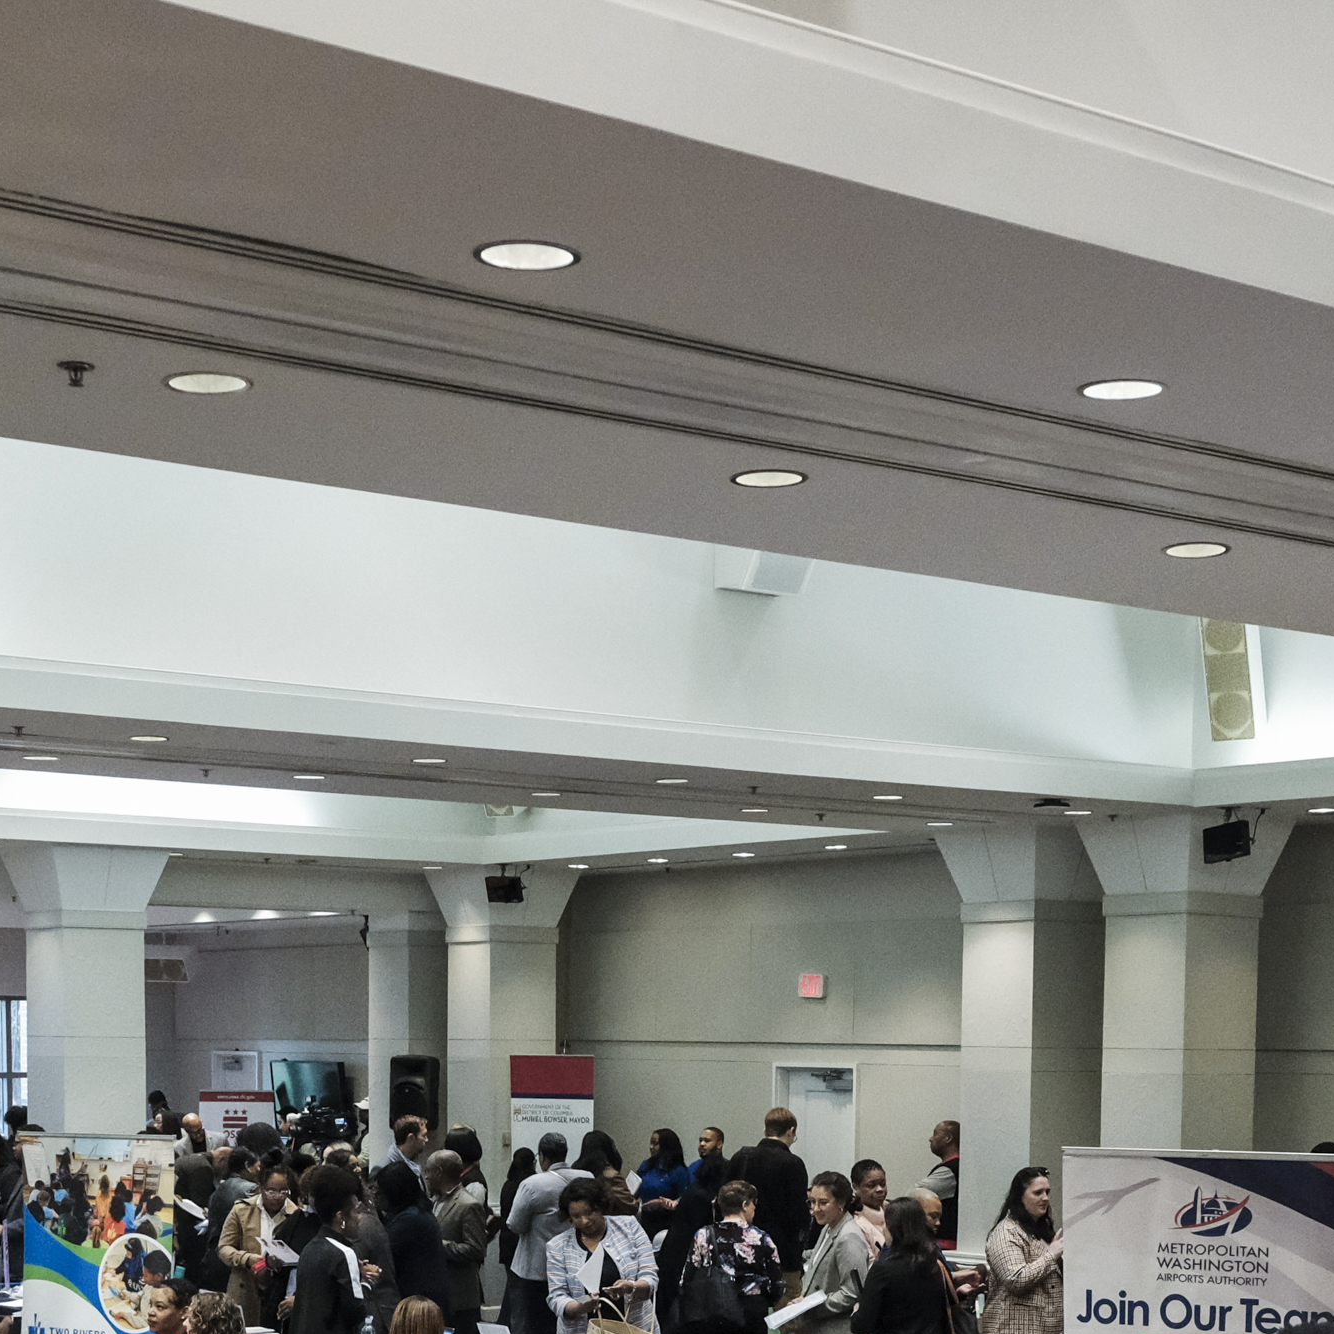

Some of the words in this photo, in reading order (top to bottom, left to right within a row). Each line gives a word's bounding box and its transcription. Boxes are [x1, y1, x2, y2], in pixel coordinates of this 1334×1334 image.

[569, 1116, 590, 1124] MAYOR
[1157, 1242, 1269, 1258] METROPOLITAN
[1156, 1257, 1269, 1274] WASHINGTON
[1156, 1273, 1204, 1285] AIRPORTS
[1206, 1276, 1268, 1287] AUTHORITY
[1076, 1289, 1150, 1327] Join
[1159, 1293, 1233, 1332] Our
